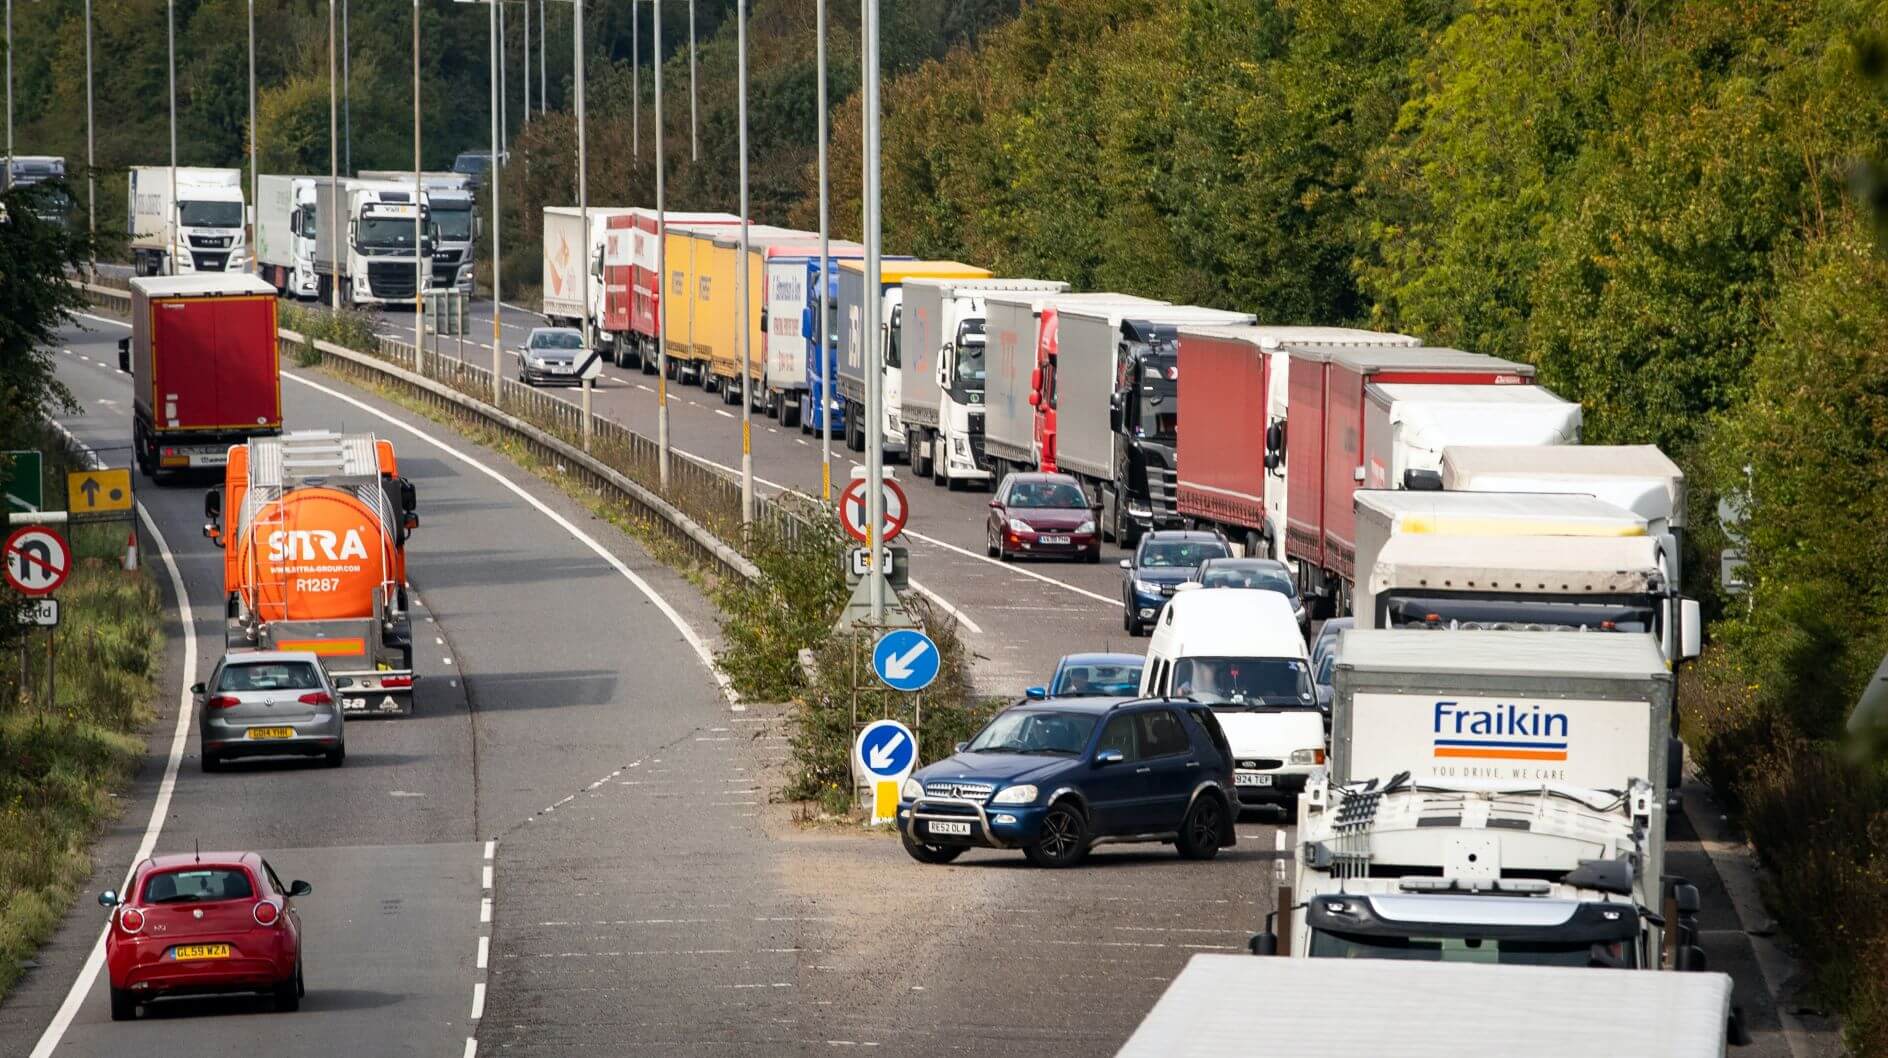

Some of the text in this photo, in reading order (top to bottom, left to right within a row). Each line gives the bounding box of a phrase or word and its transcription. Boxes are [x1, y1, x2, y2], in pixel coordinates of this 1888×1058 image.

[268, 529, 368, 561] SITRA
[296, 578, 340, 593] R1287
[1434, 702, 1568, 737] Fraikin
[1432, 766, 1456, 778] YOU
[1512, 769, 1528, 780] WE
[1536, 770, 1566, 781] CARE
[931, 822, 950, 833] RE52
[177, 945, 227, 958] GL59 WZA
